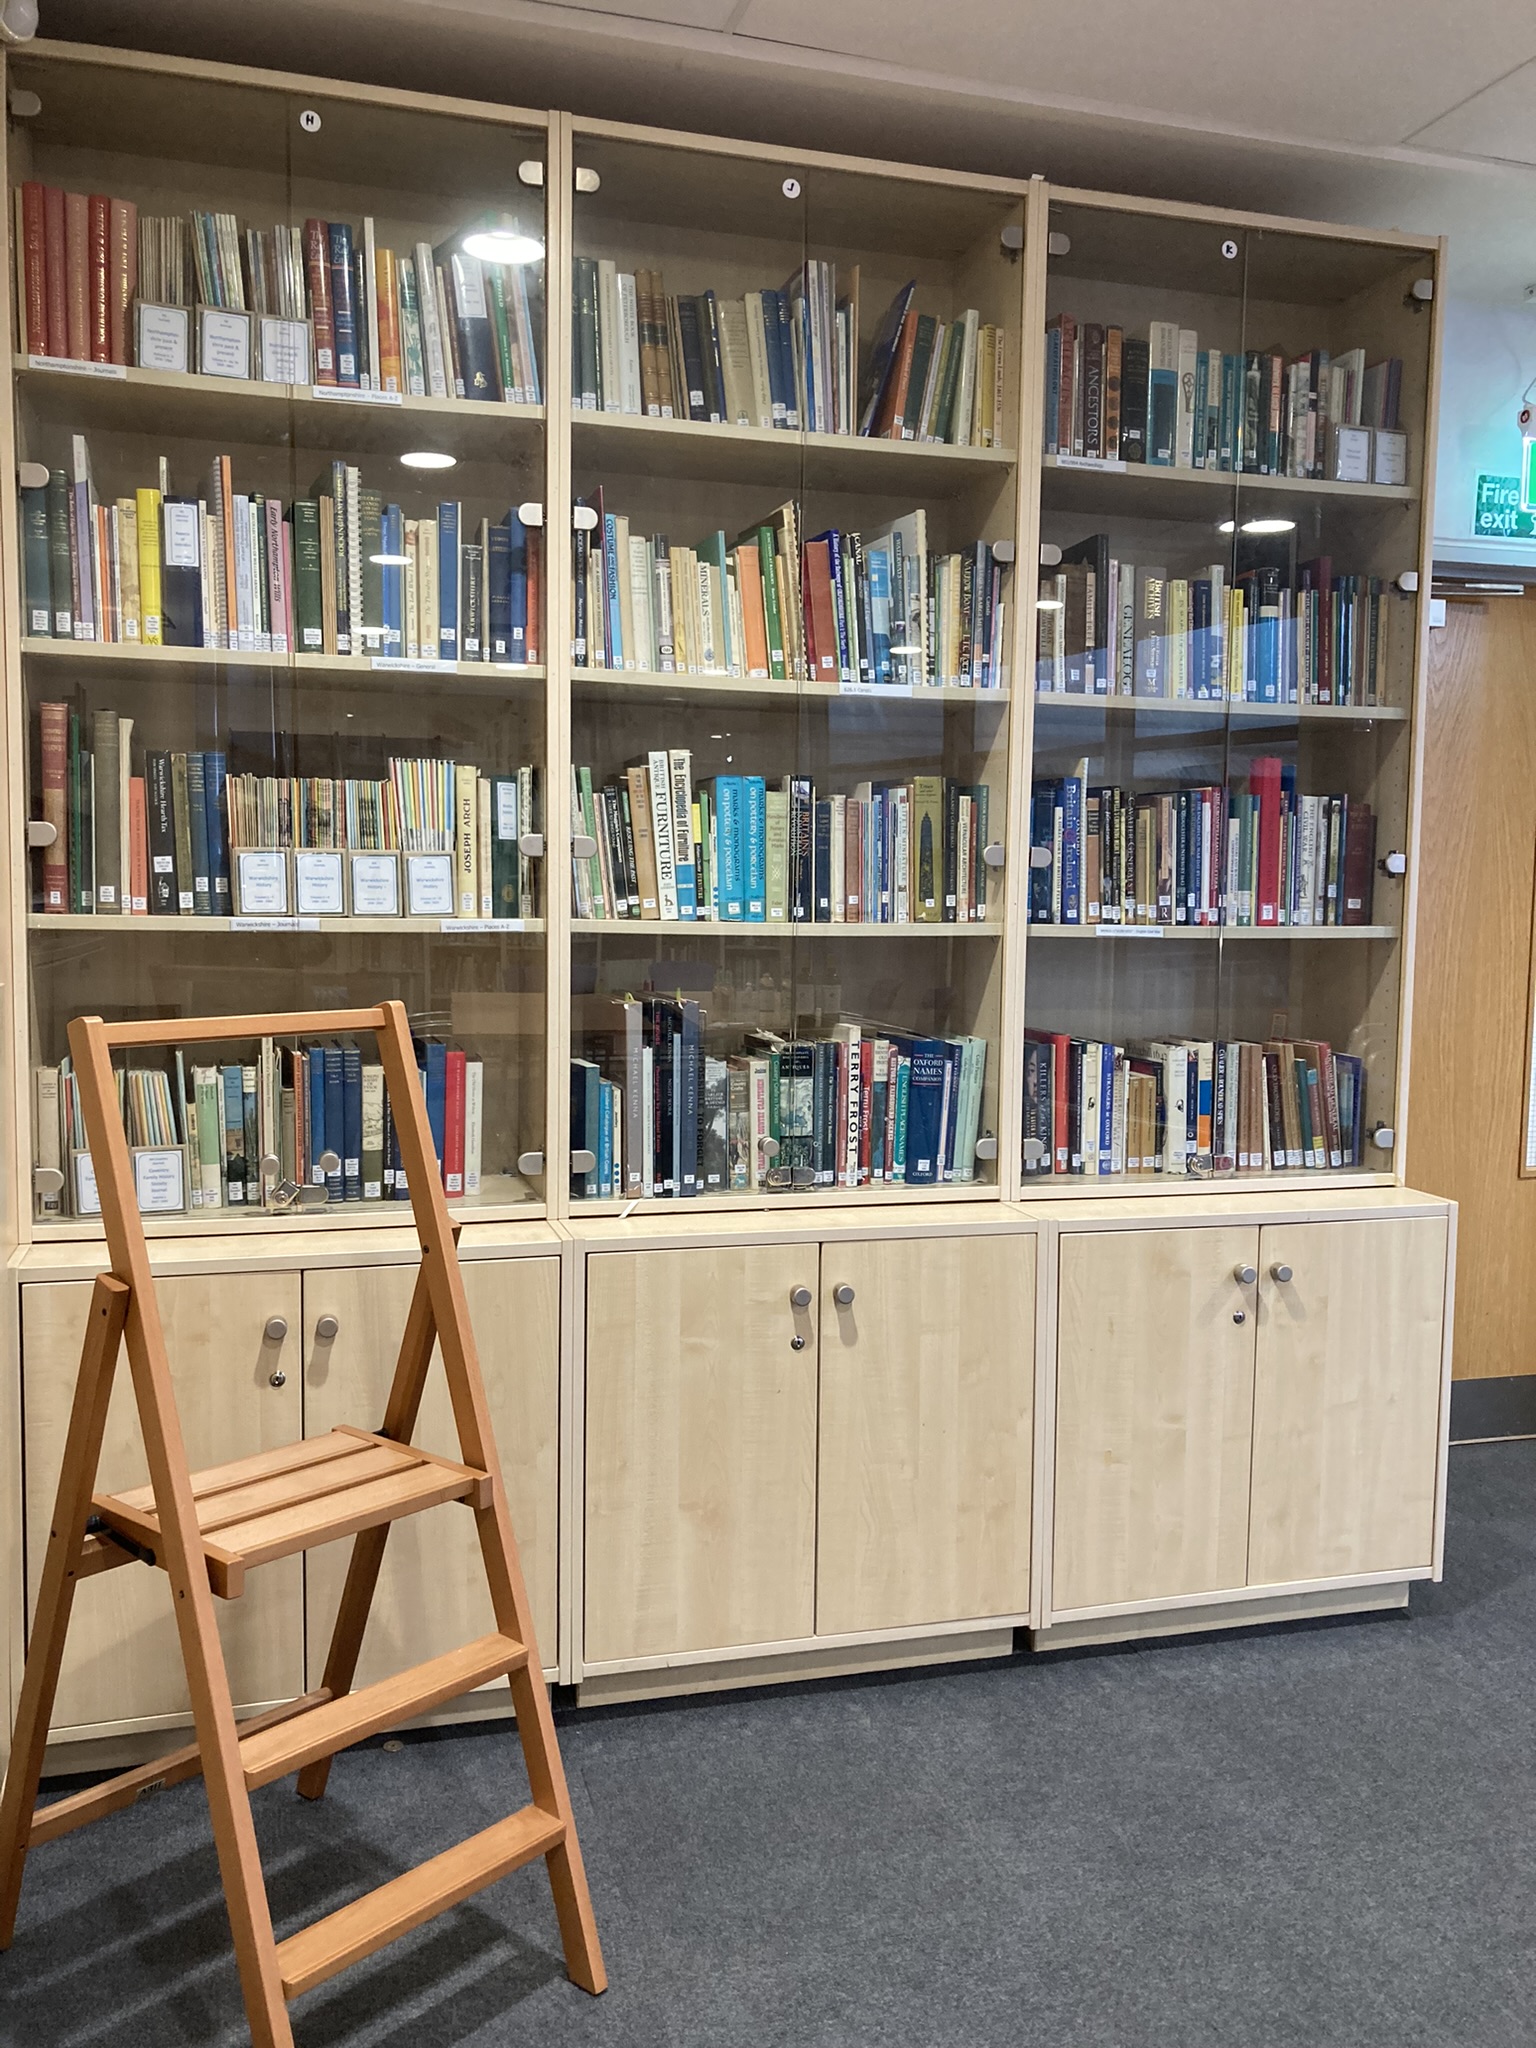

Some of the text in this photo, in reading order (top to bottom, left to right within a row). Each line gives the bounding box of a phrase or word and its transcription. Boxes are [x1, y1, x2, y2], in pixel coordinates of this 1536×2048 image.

[306, 114, 314, 125] H
[787, 183, 794, 191] J
[1226, 244, 1233, 254] K
[97, 268, 105, 344] NORTHAMPTONSHIRE
[35, 360, 117, 374] Northamptonshire Journals
[318, 390, 365, 399] Northamptonshire
[1087, 366, 1099, 444] ANCESTORS
[1482, 483, 1520, 505] Fire
[337, 503, 345, 556] ROCKINGHAM
[1480, 509, 1518, 529] exit
[270, 507, 281, 601] Early Northampton Wills
[607, 519, 617, 600] COSTUME FASHION
[854, 536, 862, 565] CANAL
[700, 566, 709, 616] MINERALS
[963, 594, 972, 613] BOAT
[1147, 577, 1155, 619] ARCHIVES
[1154, 580, 1163, 617] BRITISH
[674, 758, 685, 770] The
[675, 775, 688, 818] Encyclopedia
[723, 788, 730, 800] on
[750, 787, 756, 799] on
[656, 792, 673, 880] FURNITURE
[722, 802, 731, 836] pottery
[748, 801, 757, 836] pottery
[802, 812, 810, 856] BRITAIN'S
[902, 826, 907, 834] IN
[1066, 784, 1076, 888] Britain Ireland
[625, 826, 633, 856] RESCUING
[678, 829, 689, 862] Furniture
[724, 847, 733, 890] porcelain
[750, 846, 758, 889] porcelain
[1127, 842, 1135, 887] GENERALS
[697, 1047, 705, 1109] IMPOSSIBLE
[1326, 1049, 1338, 1132] ROUNDHEAD GENERAL
[849, 1041, 859, 1155] TERRY FROST
[697, 1113, 705, 1125] TO
[887, 1120, 895, 1141] SCENES
